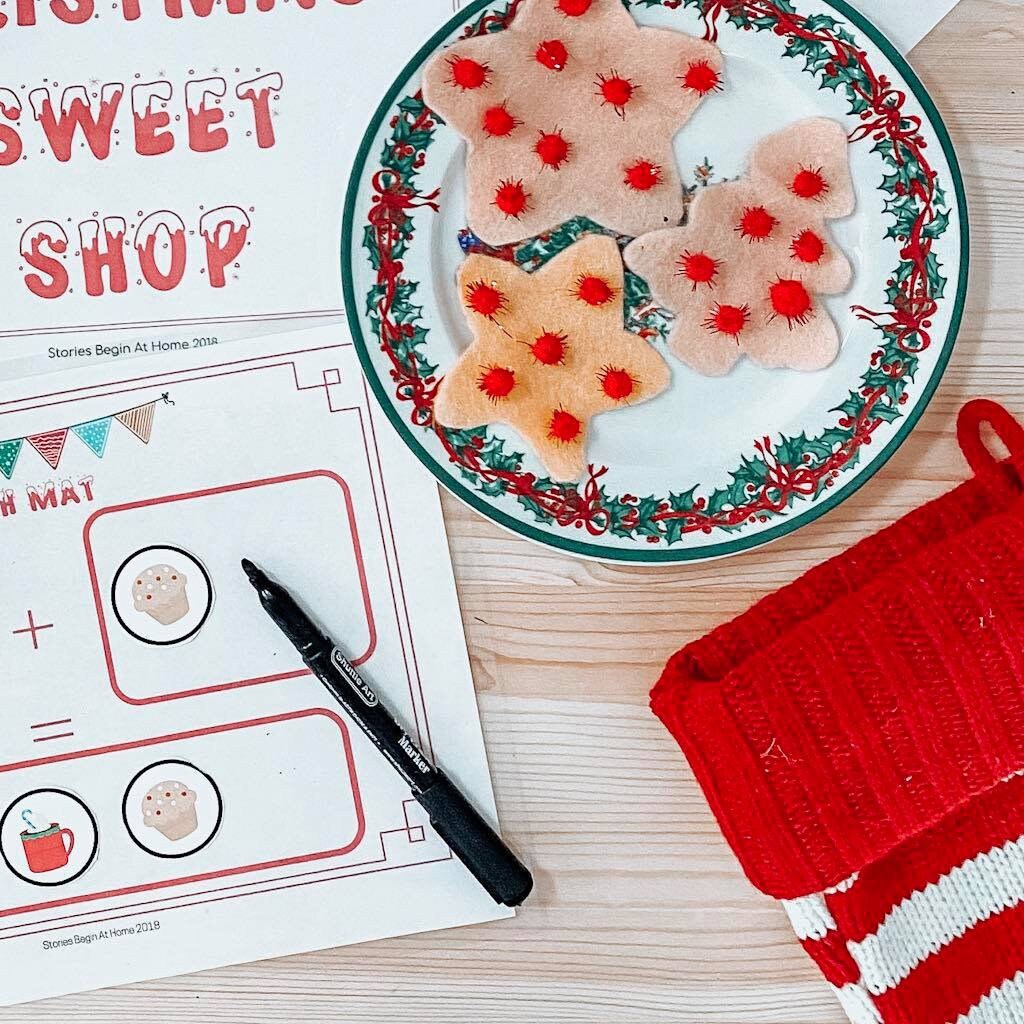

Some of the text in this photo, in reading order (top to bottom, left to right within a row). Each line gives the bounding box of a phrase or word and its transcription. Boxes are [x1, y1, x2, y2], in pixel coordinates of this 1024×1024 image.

[19, 205, 251, 299] SHOP
[48, 337, 218, 358] Stories Begin At Home 2018
[26, 475, 94, 511] MAT
[397, 735, 431, 774] Marker
[42, 920, 160, 950] Stories Begin At Home 2018
